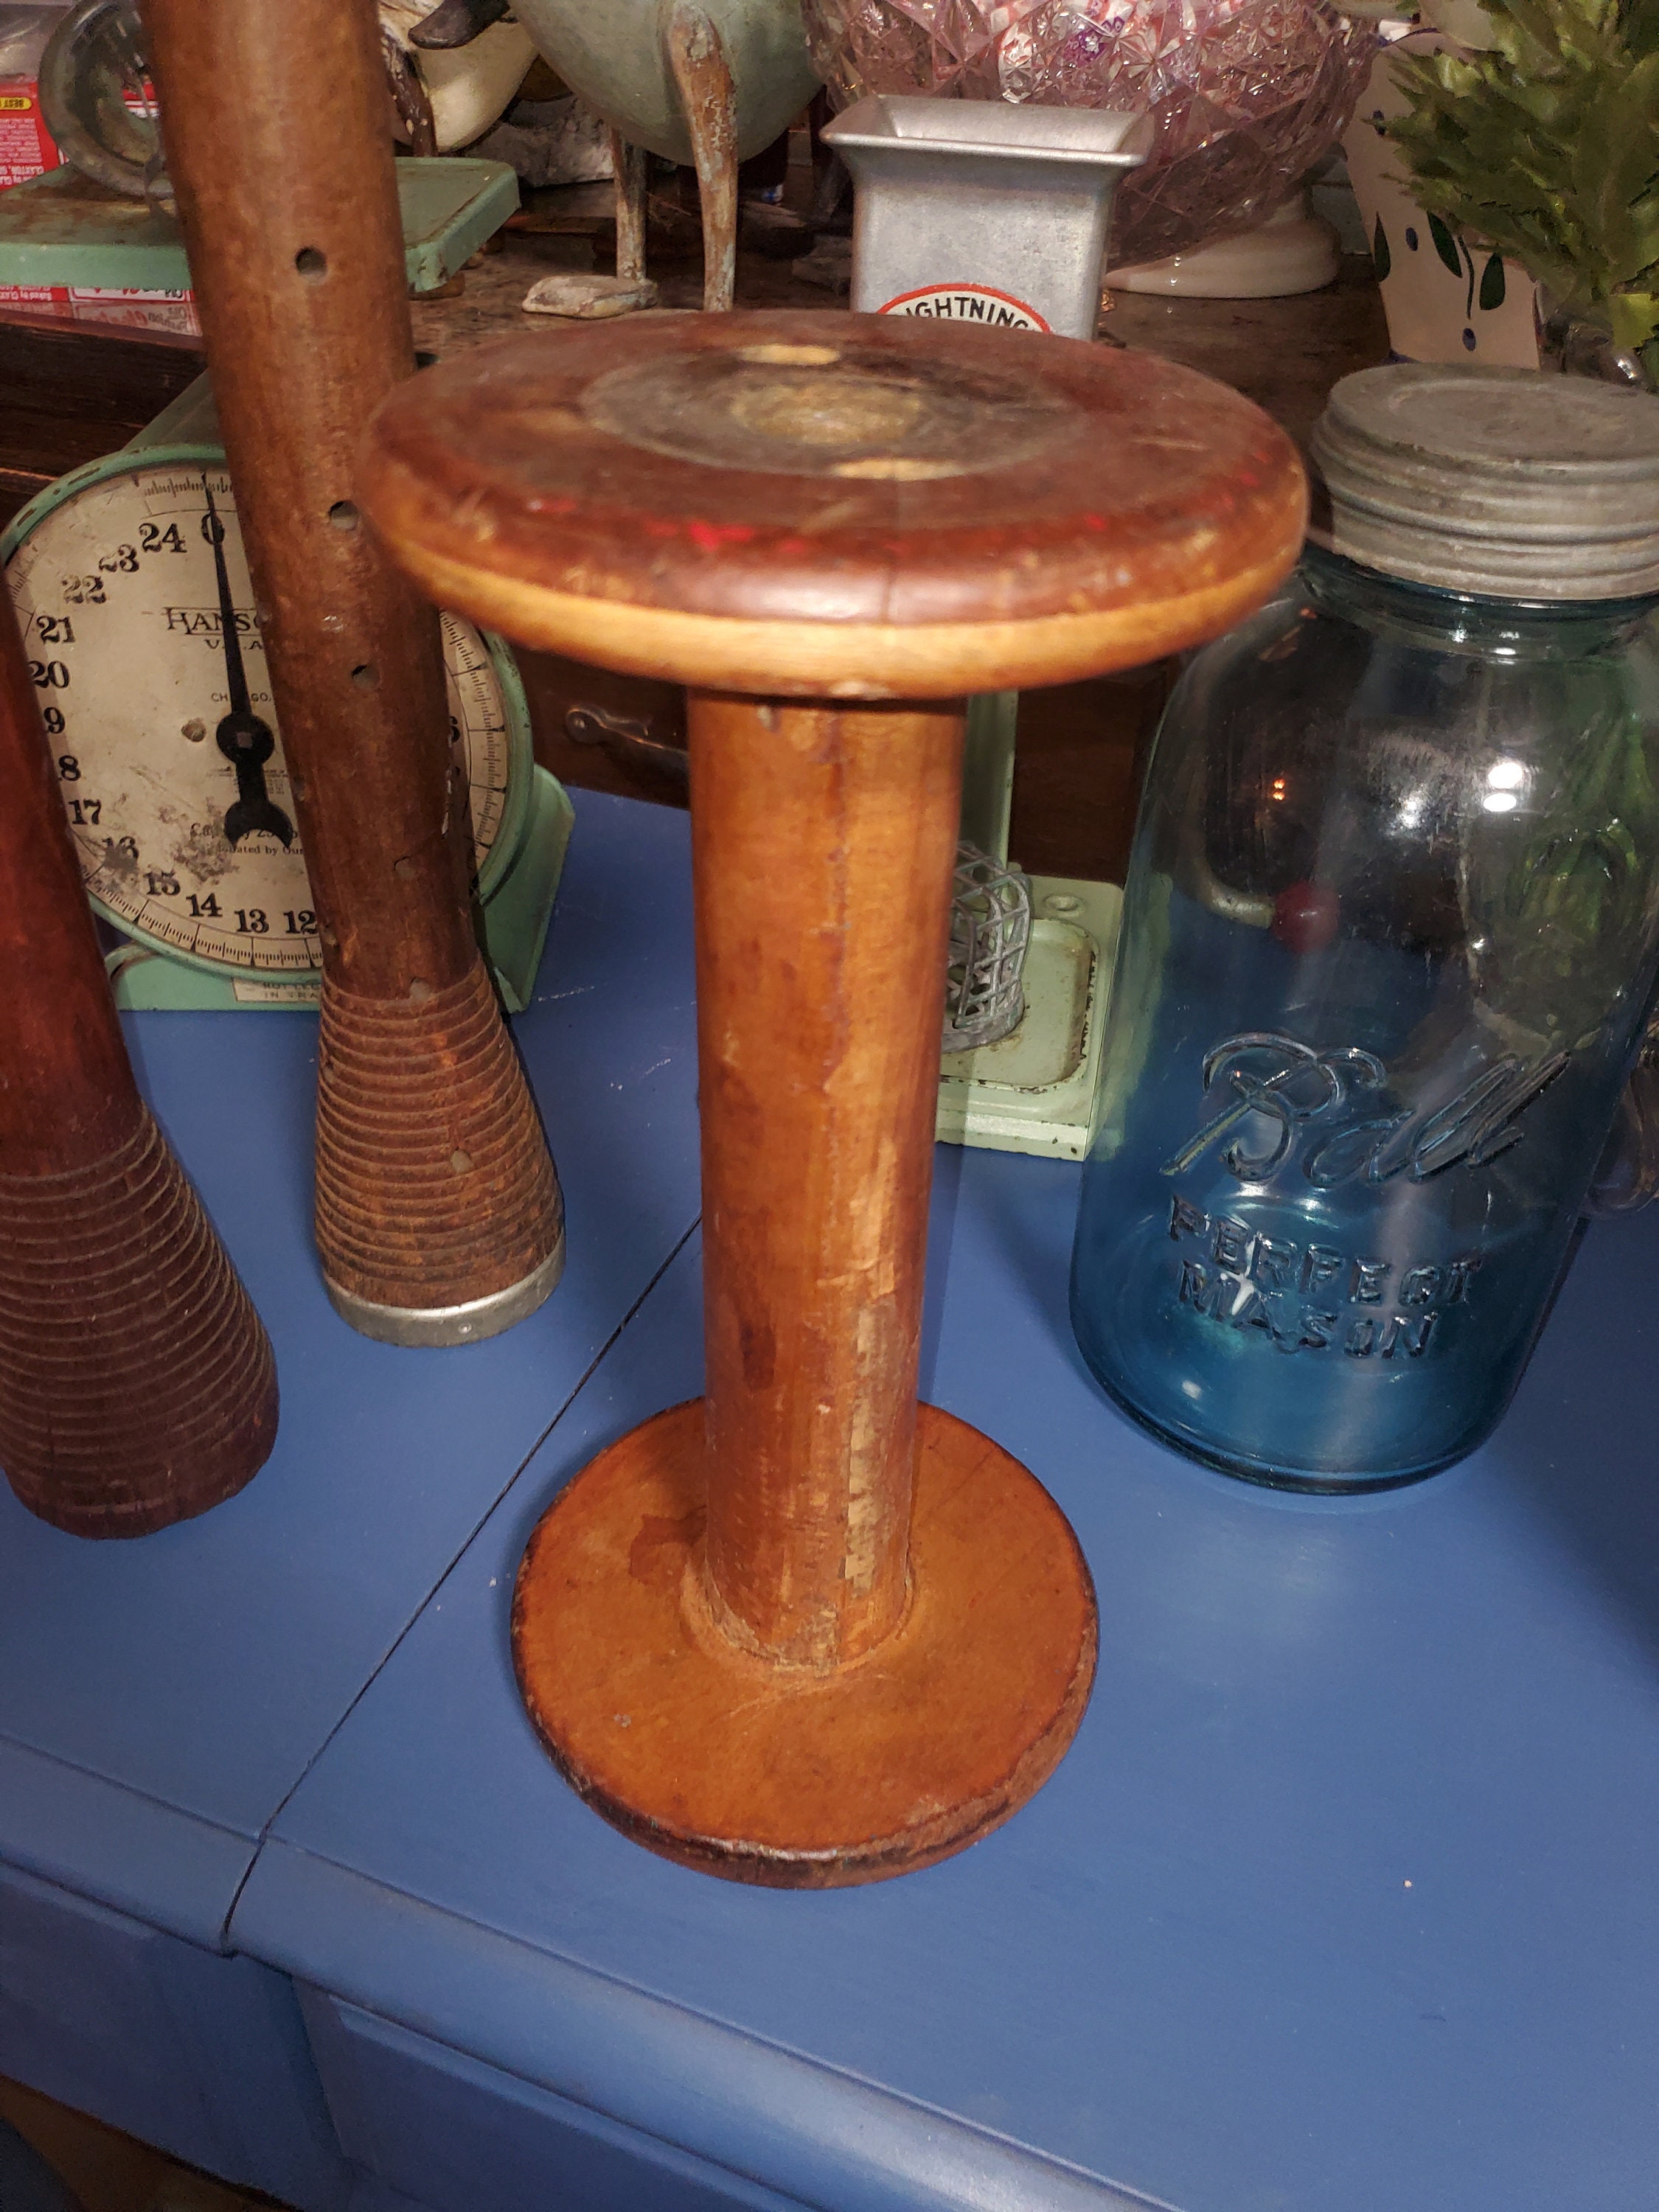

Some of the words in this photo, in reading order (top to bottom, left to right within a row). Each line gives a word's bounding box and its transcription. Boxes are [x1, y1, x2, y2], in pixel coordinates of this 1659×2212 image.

[139, 523, 187, 553] 24
[99, 544, 140, 572] 23
[62, 575, 107, 604] 22
[37, 615, 76, 644] 21
[28, 661, 70, 689] 20
[44, 706, 66, 734] 9
[57, 755, 81, 782] 8
[68, 799, 102, 825] 17
[265, 845, 279, 856] by
[143, 869, 181, 896] 15
[186, 893, 223, 917] 14
[234, 908, 269, 933] 13
[283, 911, 317, 934] 12
[1159, 1032, 1571, 1184] Ball
[1169, 1194, 1482, 1307] PERFECT
[1178, 1259, 1439, 1359] MASON
